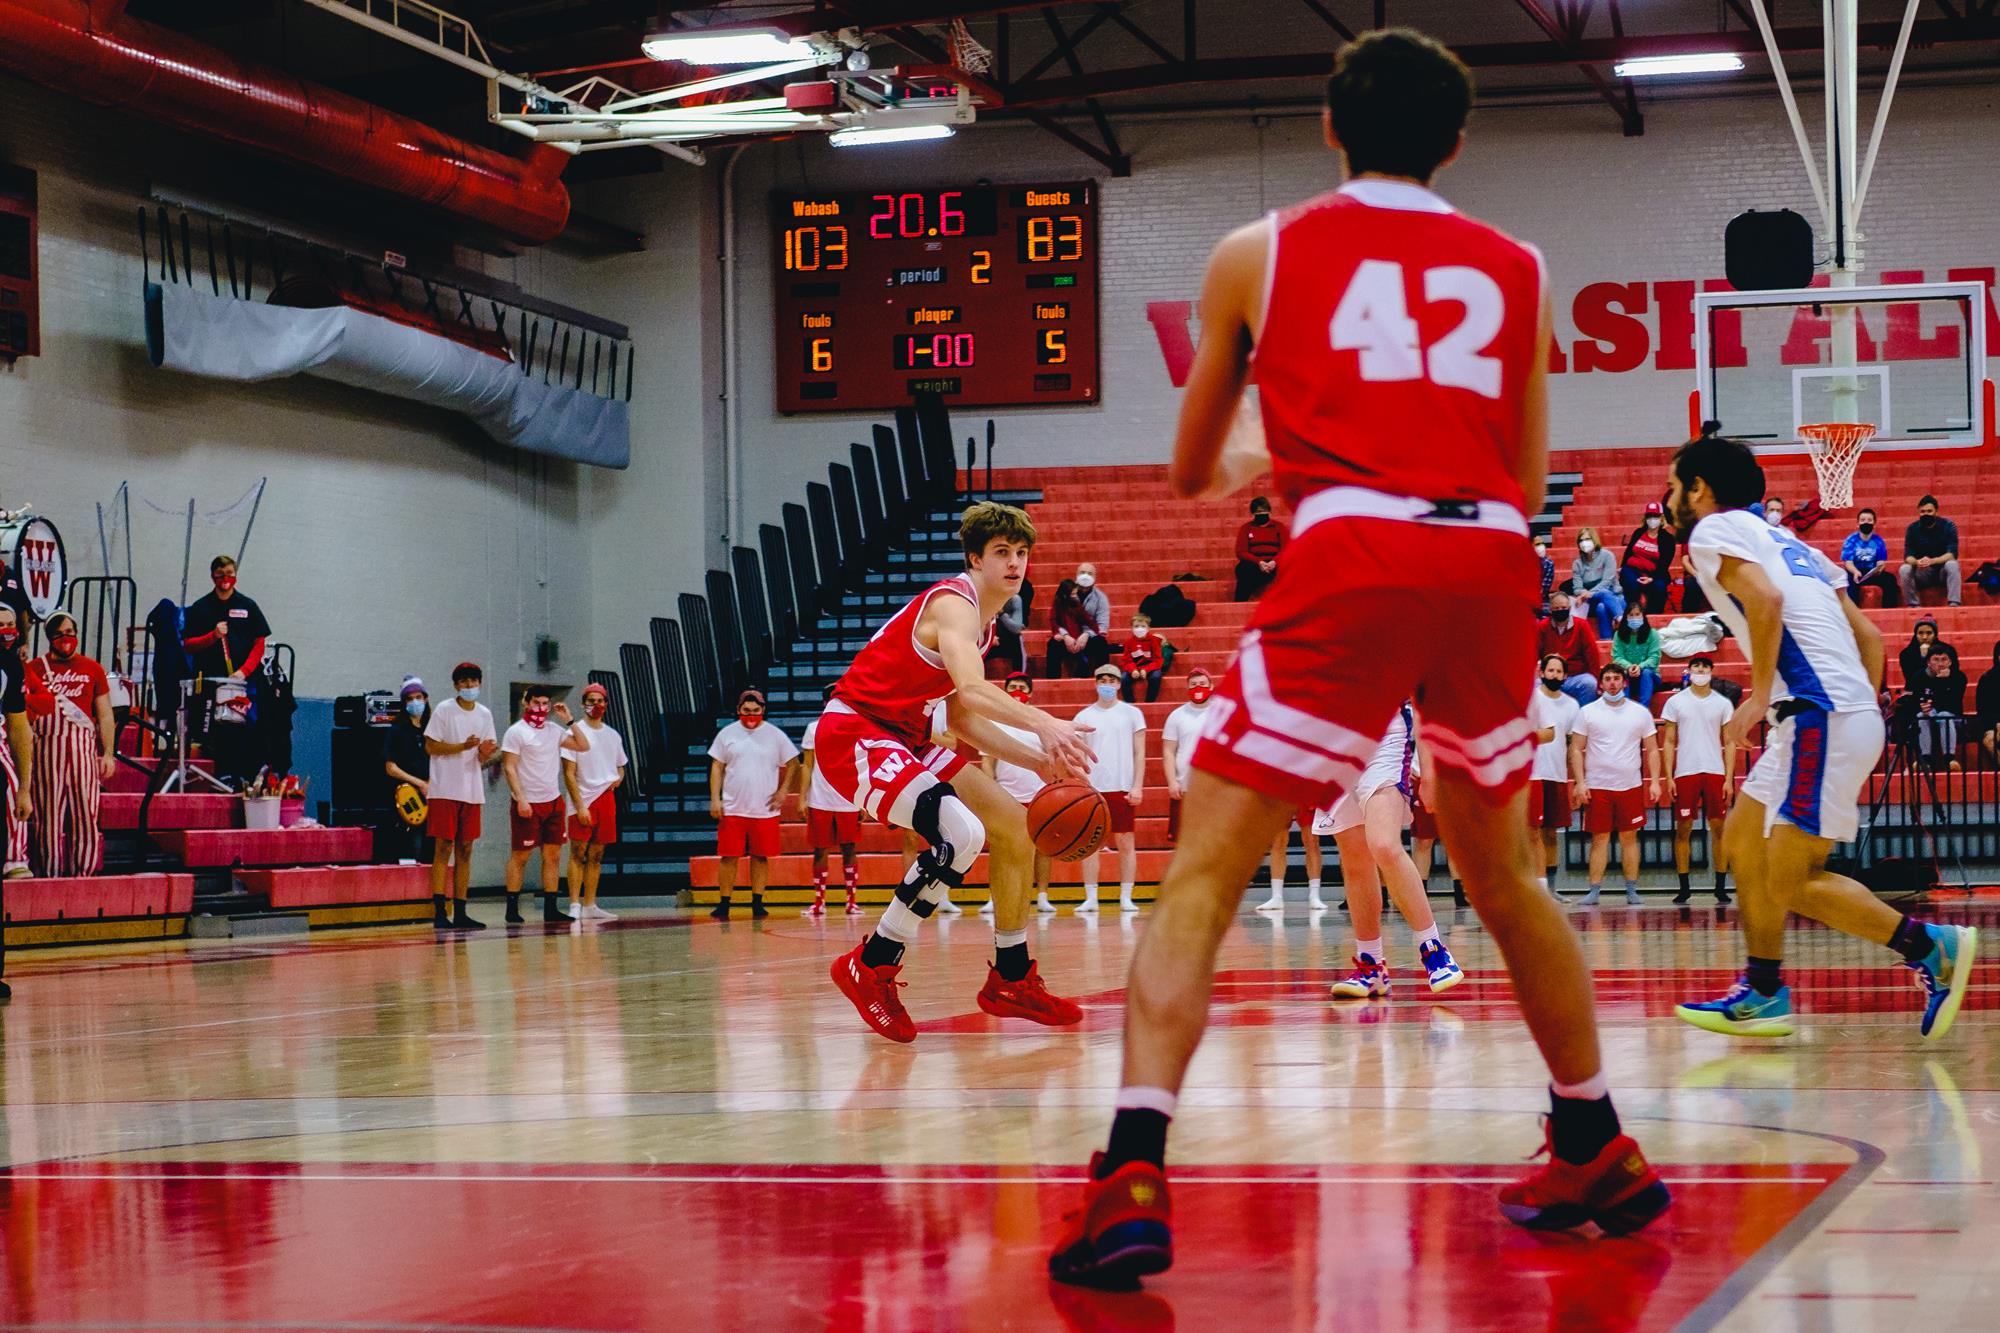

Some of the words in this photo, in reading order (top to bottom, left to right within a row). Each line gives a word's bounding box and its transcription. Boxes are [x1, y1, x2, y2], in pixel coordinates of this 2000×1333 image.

[793, 200, 840, 217] Wabash
[869, 191, 966, 239] 20.6
[1026, 191, 1071, 206] Guests
[785, 225, 848, 271] 103
[1027, 216, 1083, 261] 83
[900, 267, 940, 285] period
[971, 250, 991, 285] 2
[802, 314, 832, 329] fouls
[914, 307, 955, 325] player
[1036, 304, 1066, 320] fouls
[1328, 258, 1506, 398] 42
[811, 338, 833, 372] 6
[1044, 329, 1067, 364] 5
